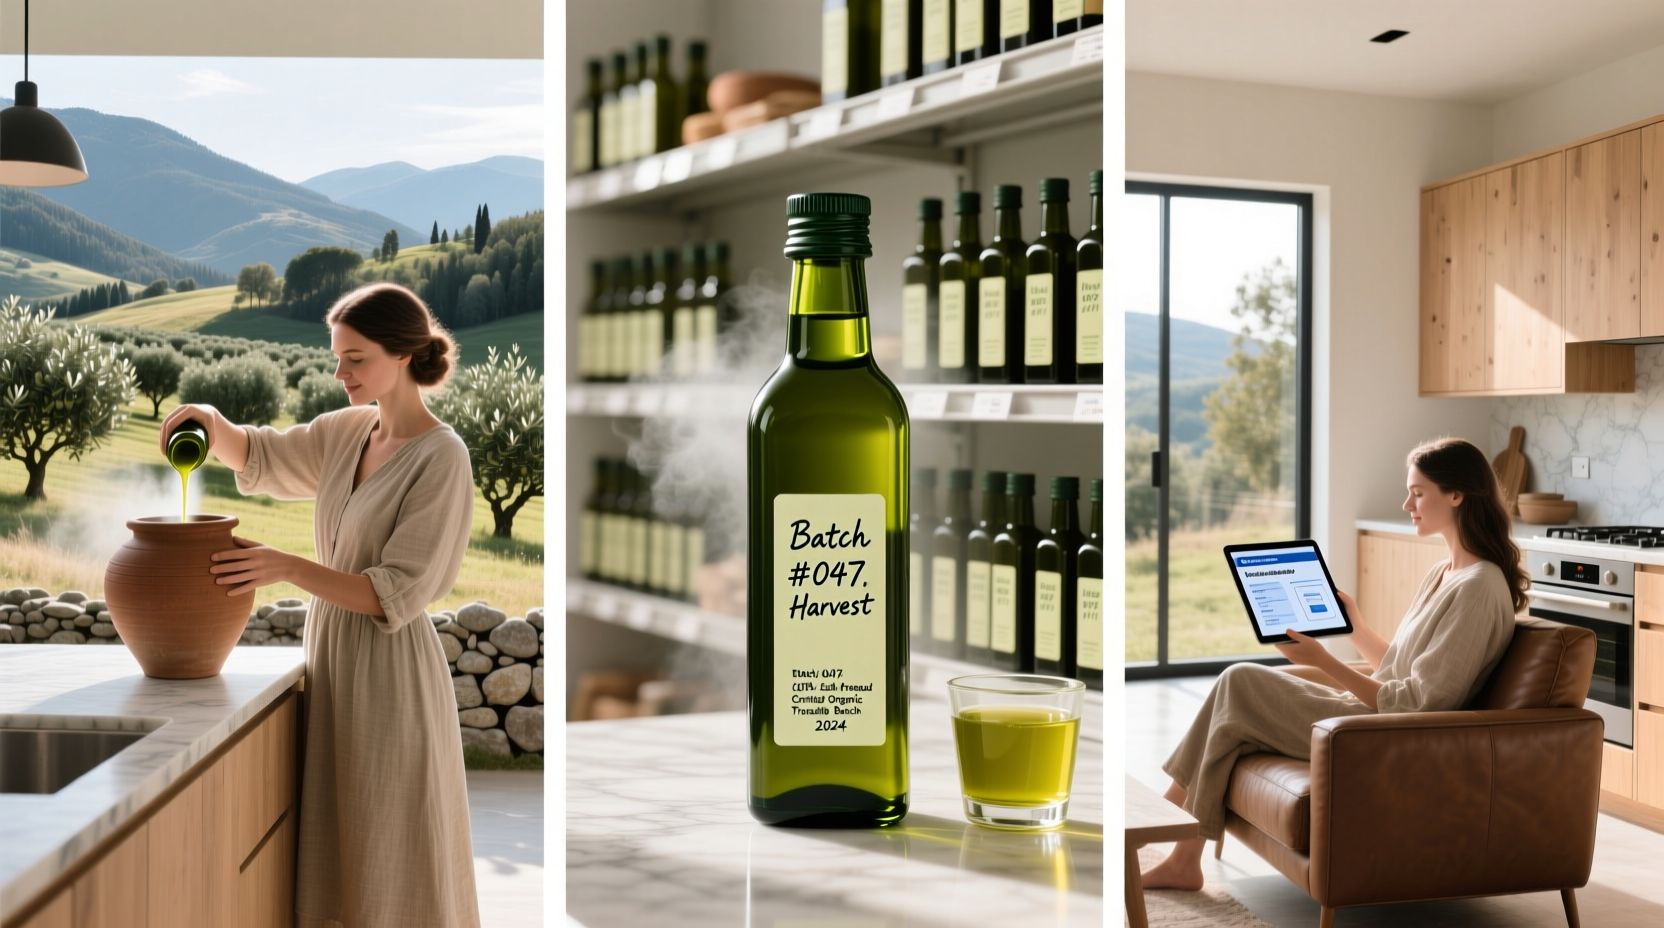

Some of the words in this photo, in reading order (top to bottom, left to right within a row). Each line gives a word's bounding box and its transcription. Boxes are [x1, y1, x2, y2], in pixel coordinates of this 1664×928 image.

[790, 518, 871, 550] Batch
[788, 561, 868, 587] #047.
[789, 592, 875, 620] Harvest
[814, 719, 847, 733] 2024
